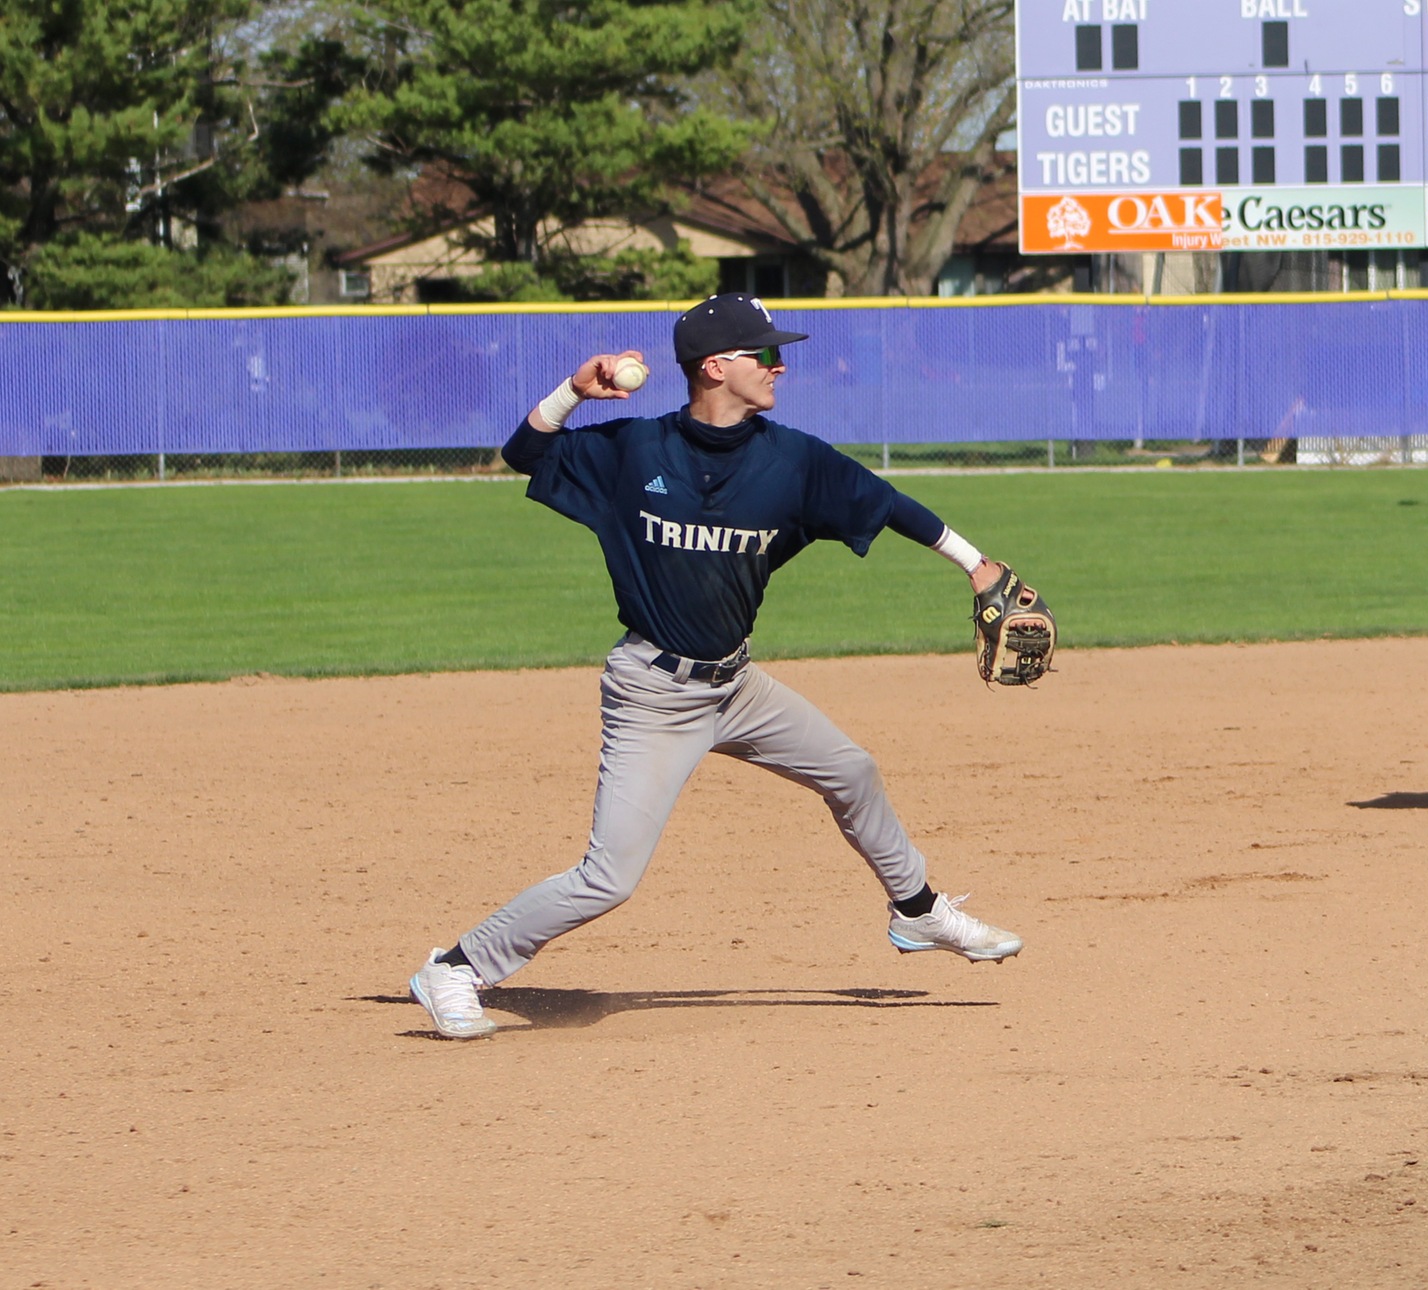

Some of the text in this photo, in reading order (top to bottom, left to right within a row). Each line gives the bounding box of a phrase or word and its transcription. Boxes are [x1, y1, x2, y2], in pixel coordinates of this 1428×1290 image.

[1062, 0, 1148, 22] AT BAT
[1186, 77, 1196, 98] 1
[1219, 76, 1232, 98] 2
[1255, 75, 1268, 97] 3
[1309, 74, 1321, 96] 4
[1345, 74, 1357, 95] 5
[1380, 73, 1393, 95] 6
[1045, 105, 1140, 137] GUEST
[1037, 150, 1151, 185] TIGERS
[1107, 194, 1220, 230] OAK
[1238, 195, 1386, 232] Caesars
[1172, 233, 1208, 249] Injury
[1256, 234, 1288, 246] NW
[1302, 232, 1416, 246] 815-929-1110
[750, 297, 773, 323] T
[639, 509, 779, 555] TRINITY
